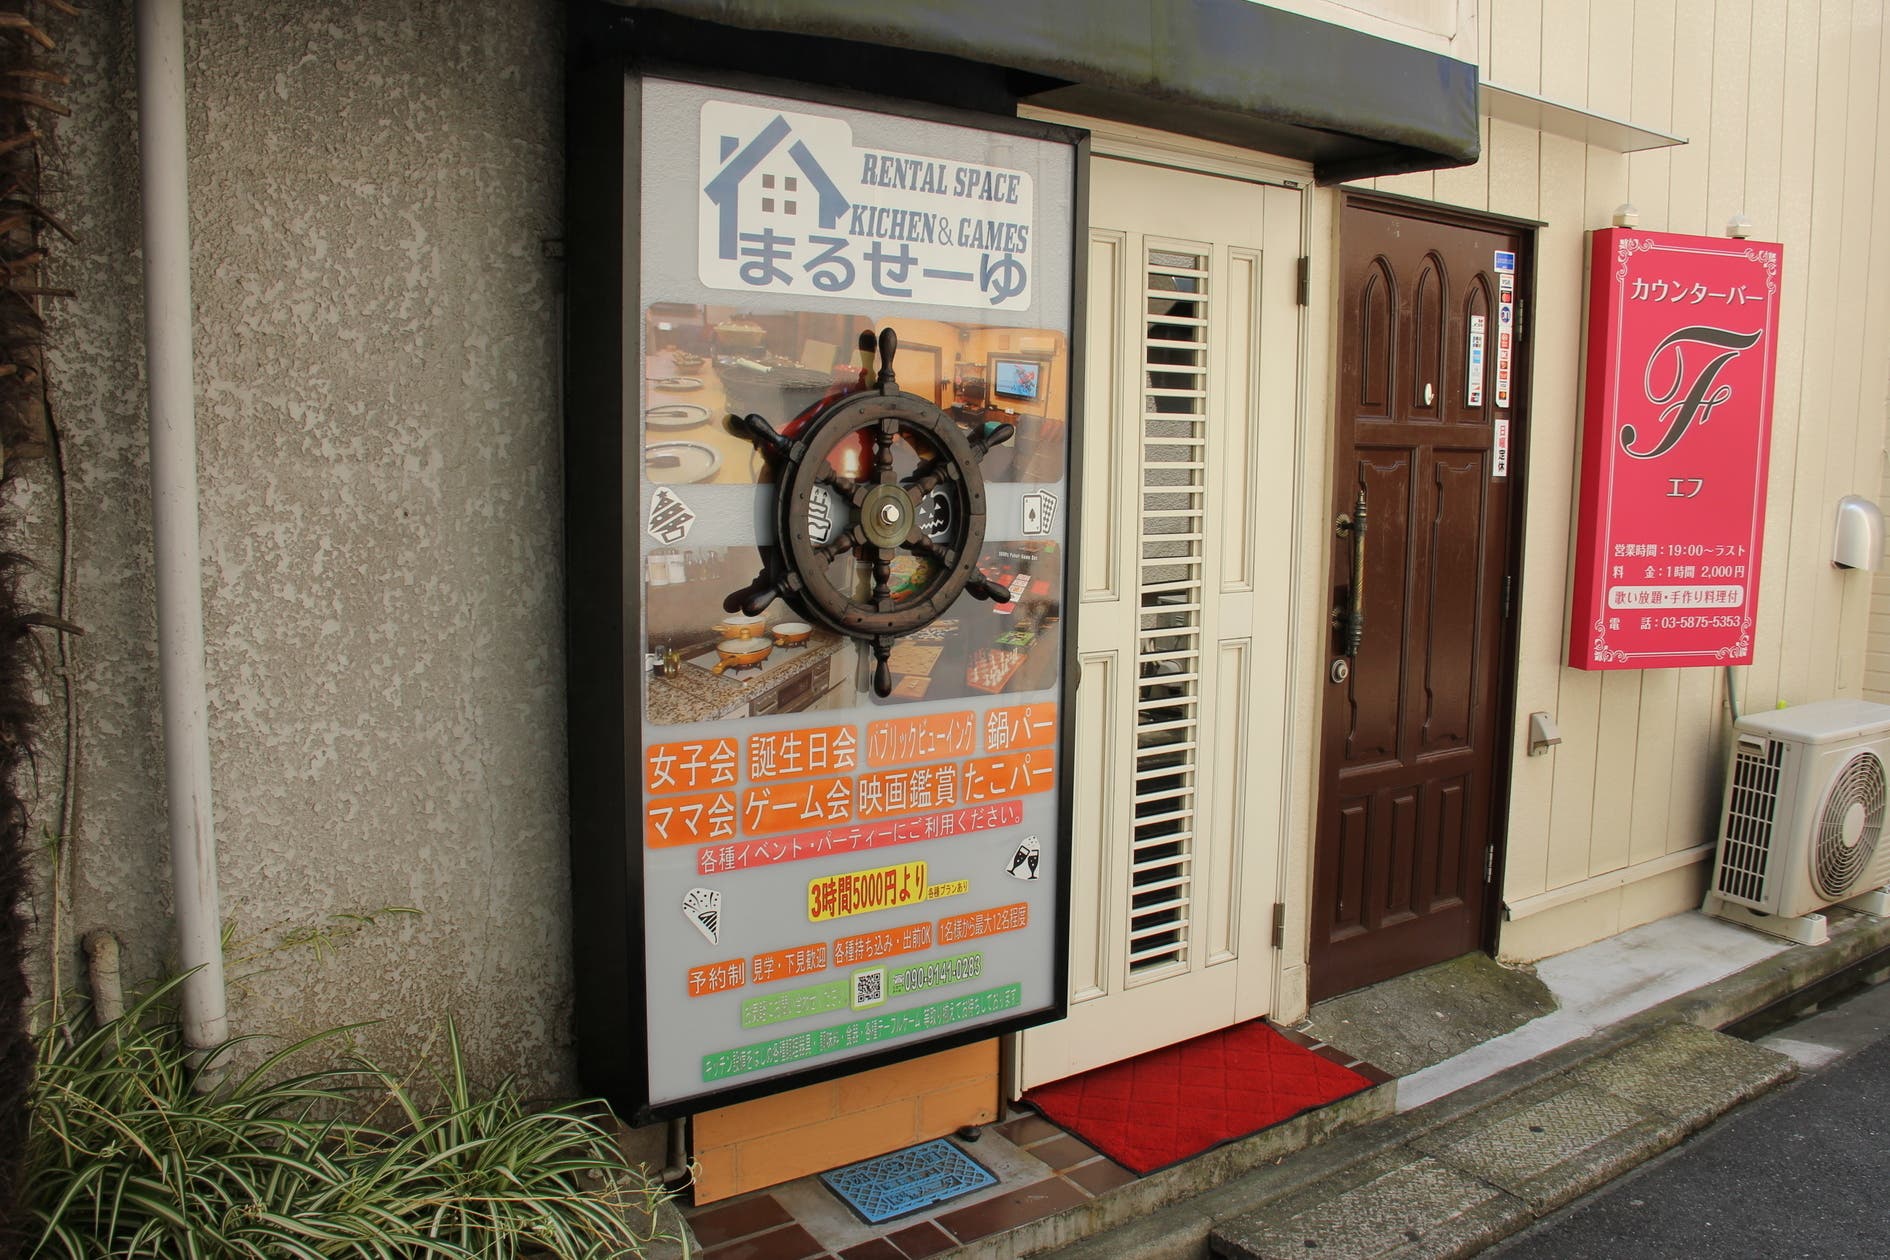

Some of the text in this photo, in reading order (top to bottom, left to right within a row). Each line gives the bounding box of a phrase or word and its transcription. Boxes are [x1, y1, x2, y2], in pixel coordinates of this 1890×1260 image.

[861, 153, 1021, 205] RENTAL SPACE
[849, 204, 1029, 254] KICHEN&GAMES
[739, 227, 1028, 306] まるせーゆ
[1631, 277, 1764, 306] カウンターバー
[1619, 325, 1763, 460] F
[1666, 477, 1704, 499] エフ
[649, 707, 1053, 790] 女子会 誕生日会 パブリックビューイング 鍋パー
[648, 753, 1053, 840] ママ会 ゲーム会 映画鑑賞 たこパー
[811, 864, 925, 918] 3時間5000円より
[689, 962, 746, 995] 予約制
